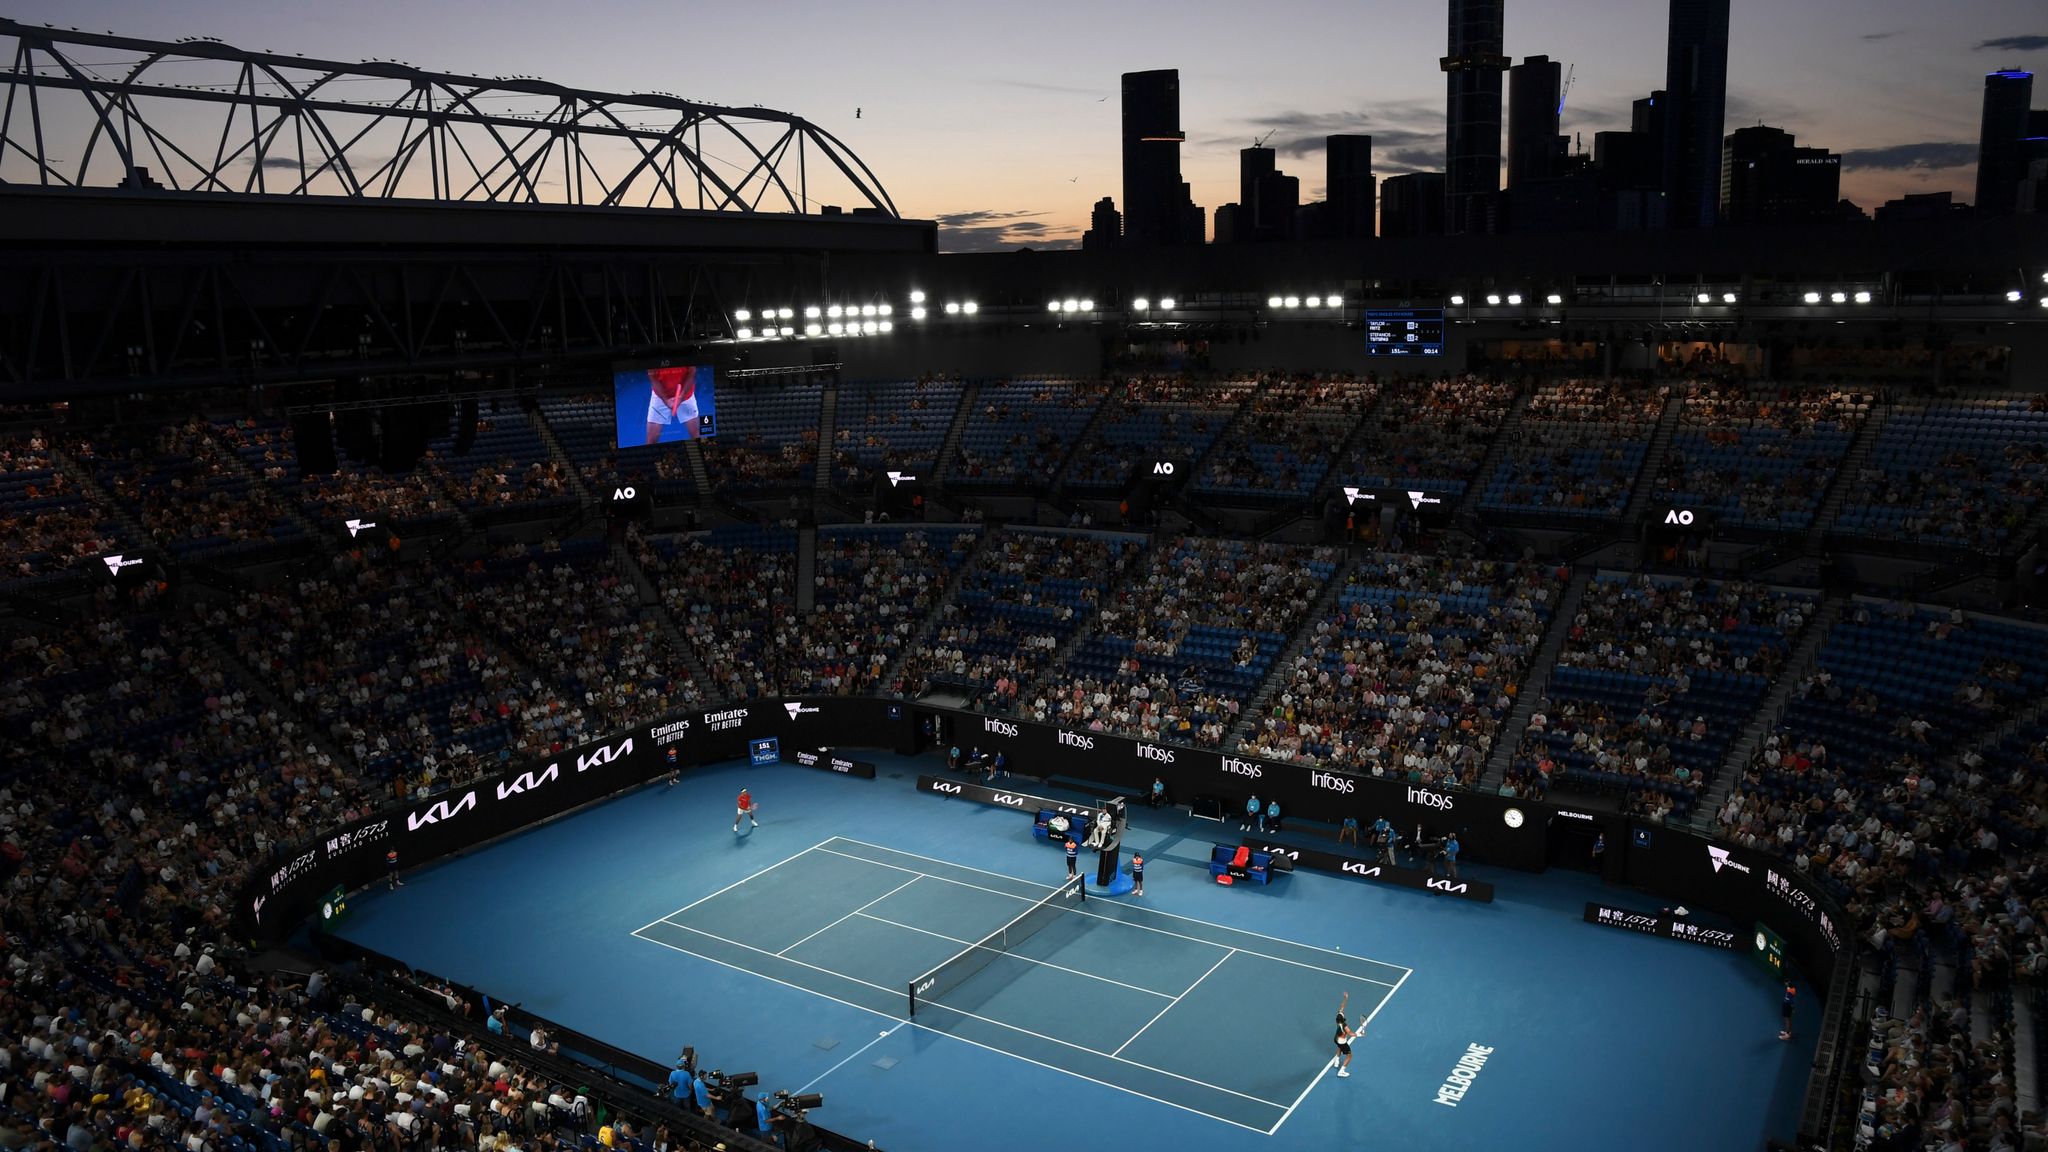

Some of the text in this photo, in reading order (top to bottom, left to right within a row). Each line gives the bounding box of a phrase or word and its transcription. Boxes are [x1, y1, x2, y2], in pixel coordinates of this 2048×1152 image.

[703, 415, 709, 424] 6
[1153, 461, 1174, 475] AO
[613, 486, 636, 501] AO
[1664, 509, 1694, 525] AO
[704, 708, 748, 724] Emirates
[711, 718, 742, 732] FLY BETTER
[650, 720, 690, 739] Emirates
[984, 717, 1019, 738] Infosys
[1058, 729, 1094, 750] Infosys
[577, 737, 634, 772] KIA
[1136, 742, 1175, 764] Infosys
[1221, 755, 1262, 779] Infosys
[496, 762, 559, 800] KIA
[1311, 770, 1354, 794] Infosys
[1407, 785, 1453, 811] Infosys
[407, 791, 477, 831] KIA
[1557, 810, 1594, 821] MELBOURNE
[1712, 856, 1750, 874] MELBOURNE
[1432, 1042, 1495, 1108] MELBOURNE
